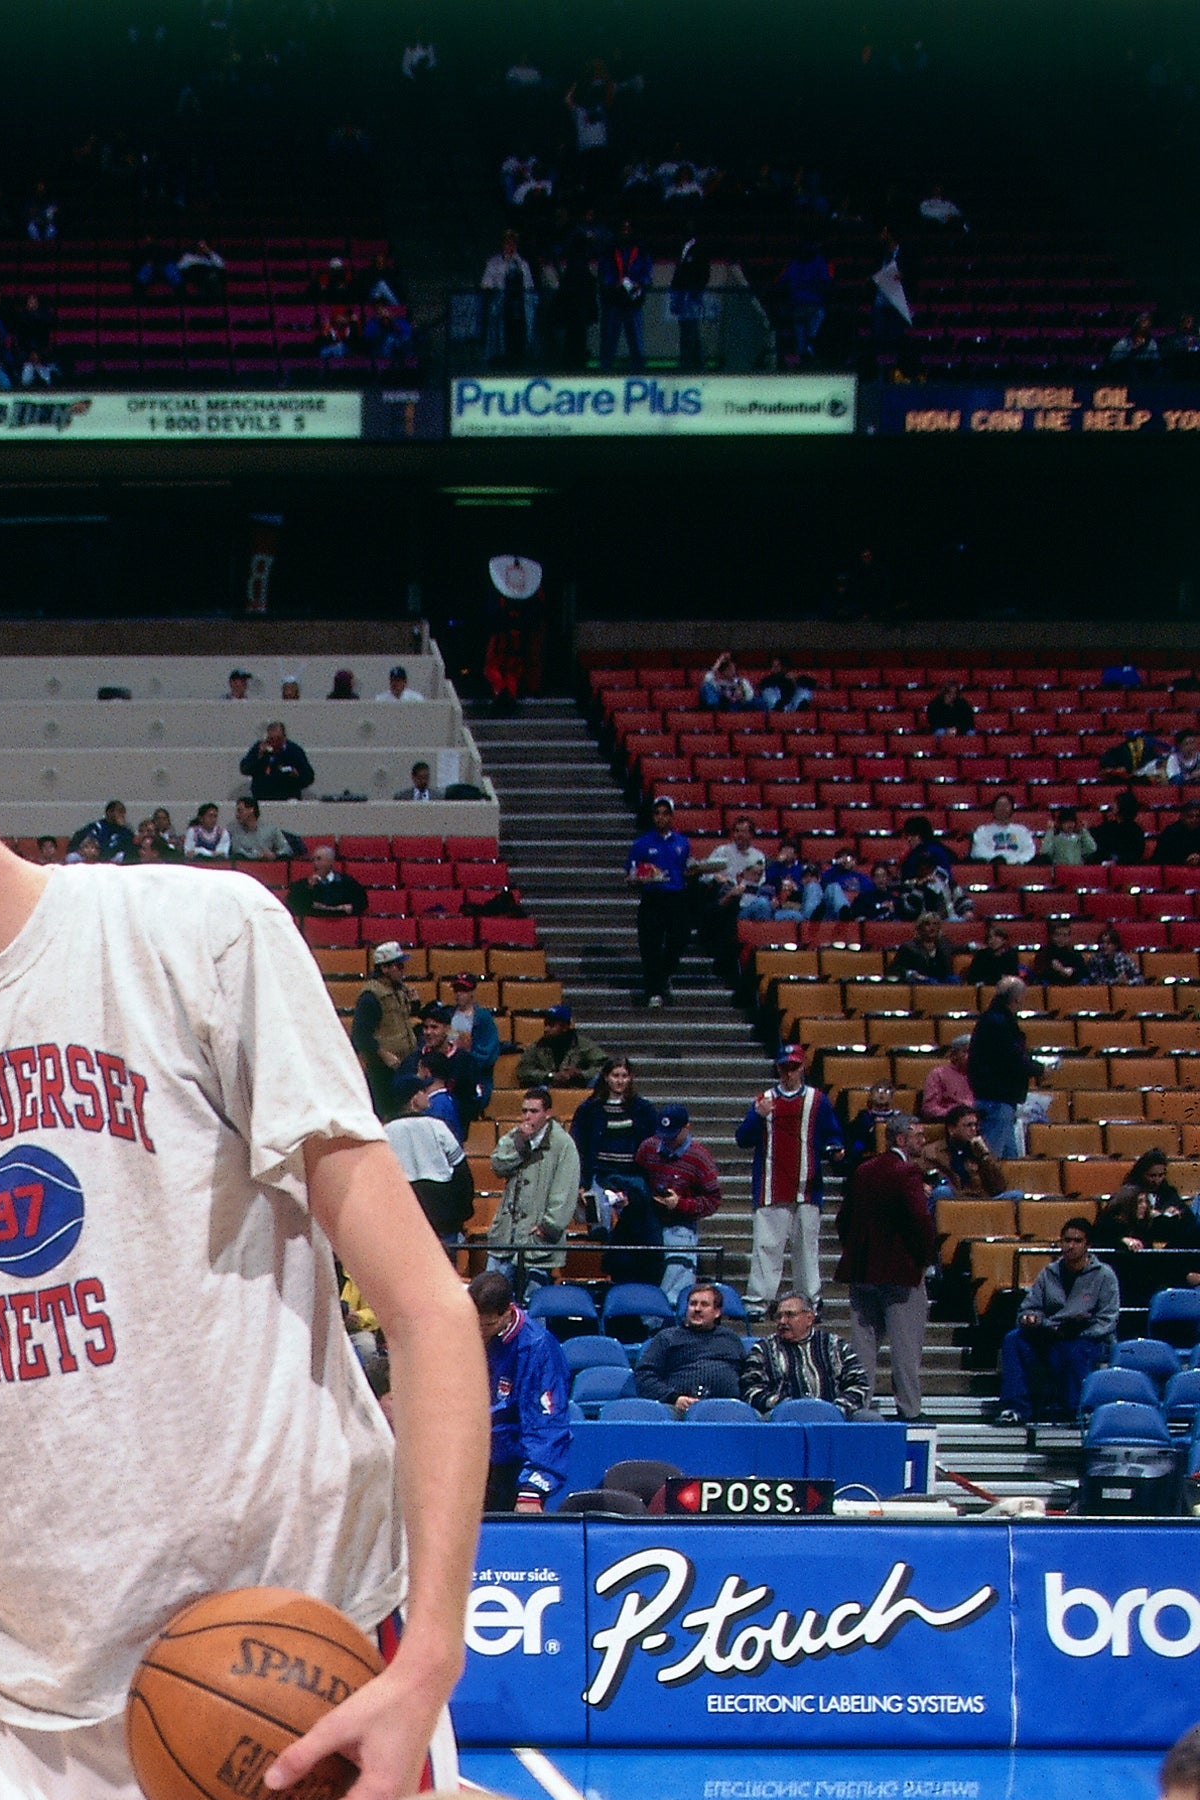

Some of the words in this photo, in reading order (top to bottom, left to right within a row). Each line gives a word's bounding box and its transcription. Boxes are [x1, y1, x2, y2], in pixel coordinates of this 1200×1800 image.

[126, 398, 200, 412] OFFICIAL
[205, 398, 326, 412] MERCHANDISE
[456, 378, 615, 416] PruCare
[624, 378, 702, 416] Plus
[700, 1481, 801, 1514] POSS.
[479, 1569, 492, 1581] at
[494, 1572, 527, 1585] your
[527, 1568, 559, 1581] side.
[582, 1547, 995, 1706] P-touch
[230, 1637, 353, 1706] SPALD
[707, 1694, 812, 1713] ELECTRONIC
[818, 1694, 903, 1713] LABELING
[906, 1694, 984, 1714] SYSTEMS
